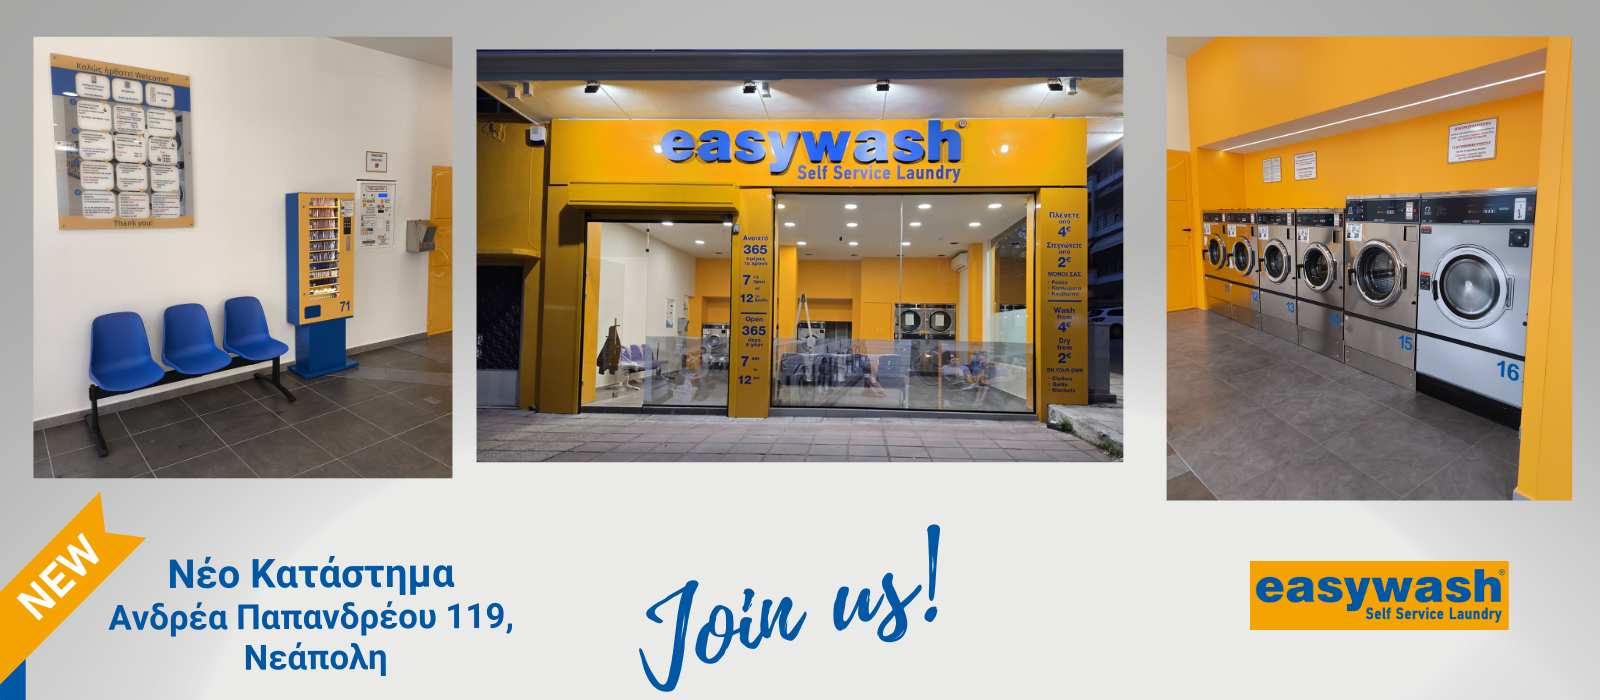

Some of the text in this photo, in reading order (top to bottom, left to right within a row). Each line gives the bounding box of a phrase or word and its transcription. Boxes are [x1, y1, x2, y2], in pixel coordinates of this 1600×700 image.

[76, 62, 169, 83] Καλώς ήρθατε! Welcome!
[797, 165, 961, 183] Self Service Laundry
[1058, 226, 1071, 237] 4€
[743, 244, 767, 254] 365
[1058, 256, 1071, 268] 2€
[743, 275, 751, 285] 7
[1224, 284, 1230, 293] 11
[740, 294, 753, 302] 12
[1251, 291, 1258, 301] 12
[340, 300, 350, 312] 71
[1287, 302, 1295, 313] 13
[1329, 312, 1340, 326] 14
[742, 326, 766, 336] 365
[1058, 322, 1071, 333] 4€
[1399, 335, 1413, 350] 15
[741, 356, 749, 367] 7
[1058, 352, 1071, 364] 2€
[1497, 360, 1519, 382] 16
[738, 375, 751, 385] 12
